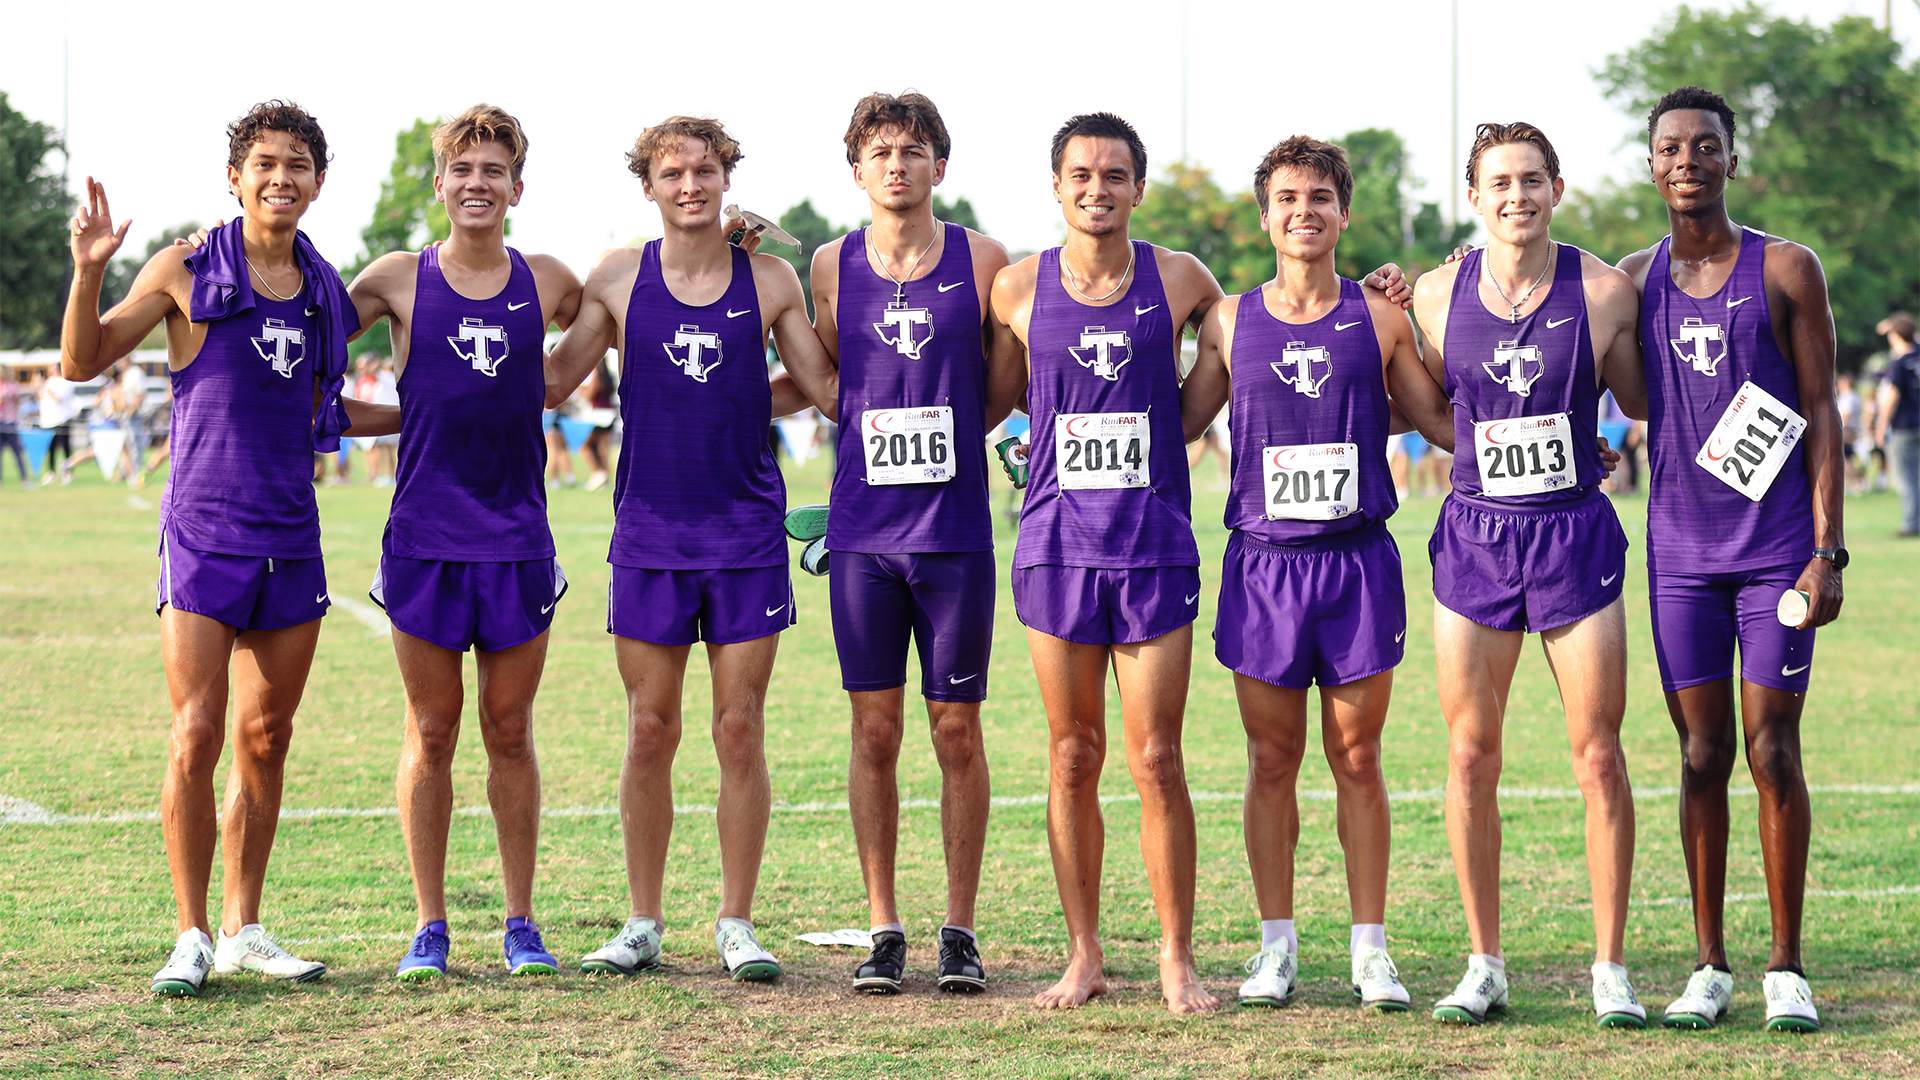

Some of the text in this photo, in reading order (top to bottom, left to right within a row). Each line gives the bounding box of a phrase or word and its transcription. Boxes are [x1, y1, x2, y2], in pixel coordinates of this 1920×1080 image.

[263, 324, 303, 371] T
[459, 323, 504, 370] T
[884, 307, 928, 353] T
[1679, 324, 1721, 371] T
[674, 330, 718, 376] T
[1080, 331, 1127, 376] T
[1283, 346, 1325, 393] T
[1494, 345, 1538, 392] T
[905, 410, 940, 420] RunFAR
[1101, 416, 1137, 426] RunFAR
[1520, 418, 1556, 430] RunFAR
[870, 431, 947, 467] 2016
[1064, 438, 1142, 471] 2014
[1484, 439, 1566, 479] 2013
[1722, 407, 1789, 487] 2011
[1271, 469, 1350, 505] 2017
